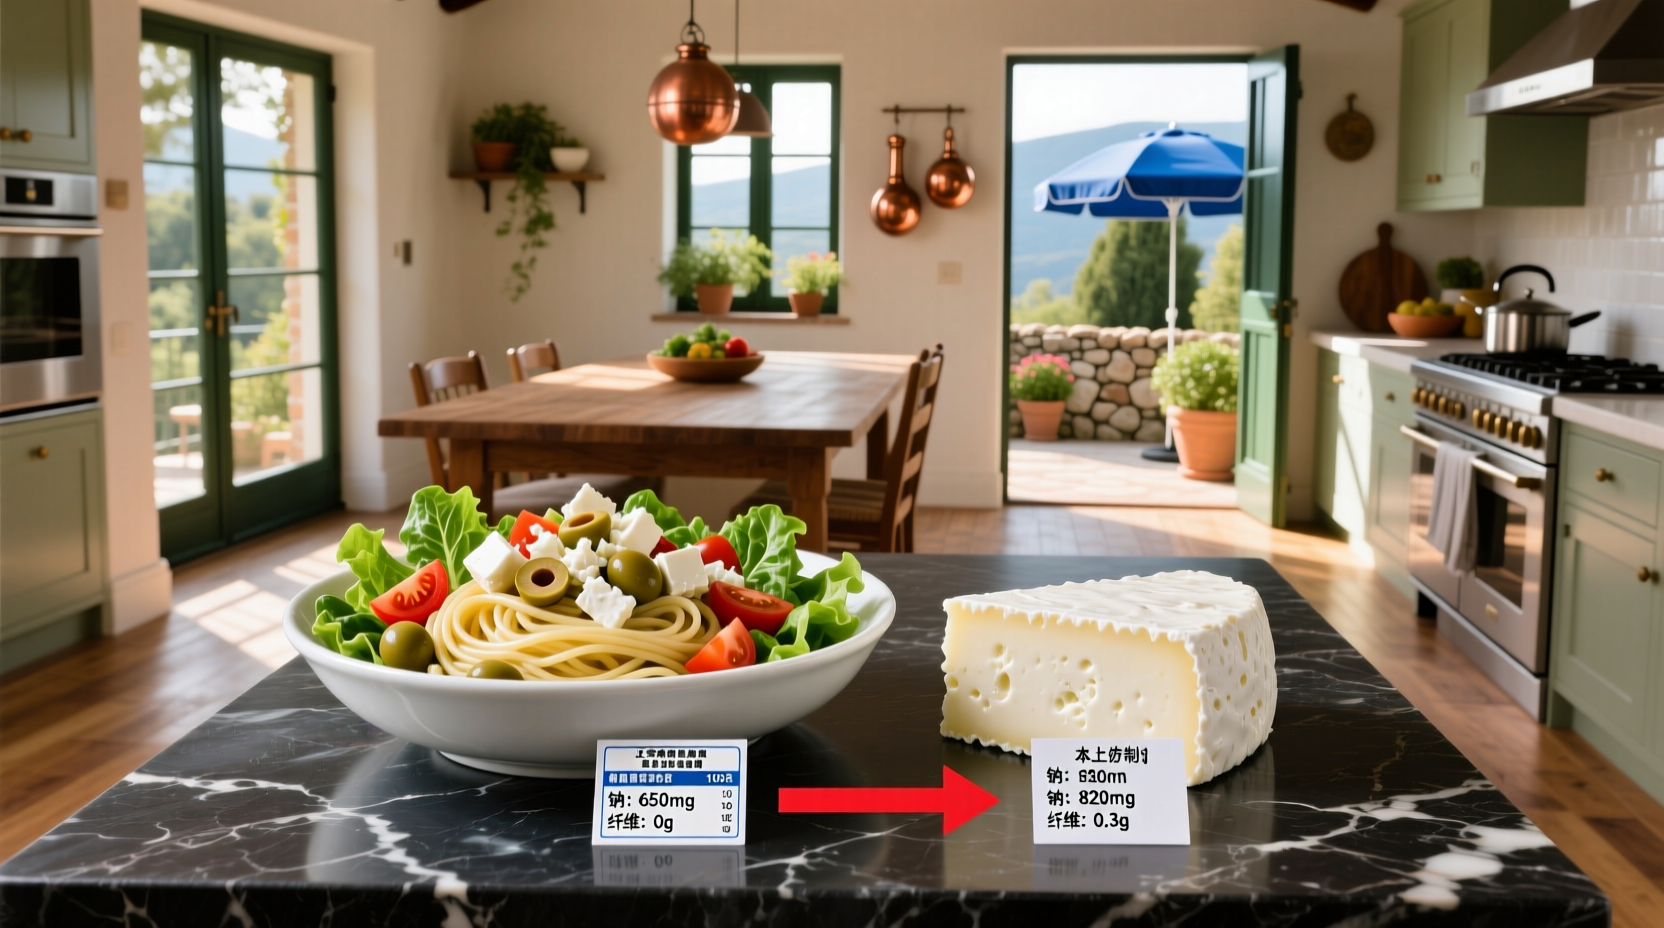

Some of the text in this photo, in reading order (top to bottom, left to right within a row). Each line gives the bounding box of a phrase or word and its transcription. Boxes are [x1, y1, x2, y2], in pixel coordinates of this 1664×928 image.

[638, 792, 695, 811] 650mg
[1078, 790, 1135, 809] 820mg
[653, 814, 674, 833] 0g
[1093, 812, 1130, 832] 0.3g
